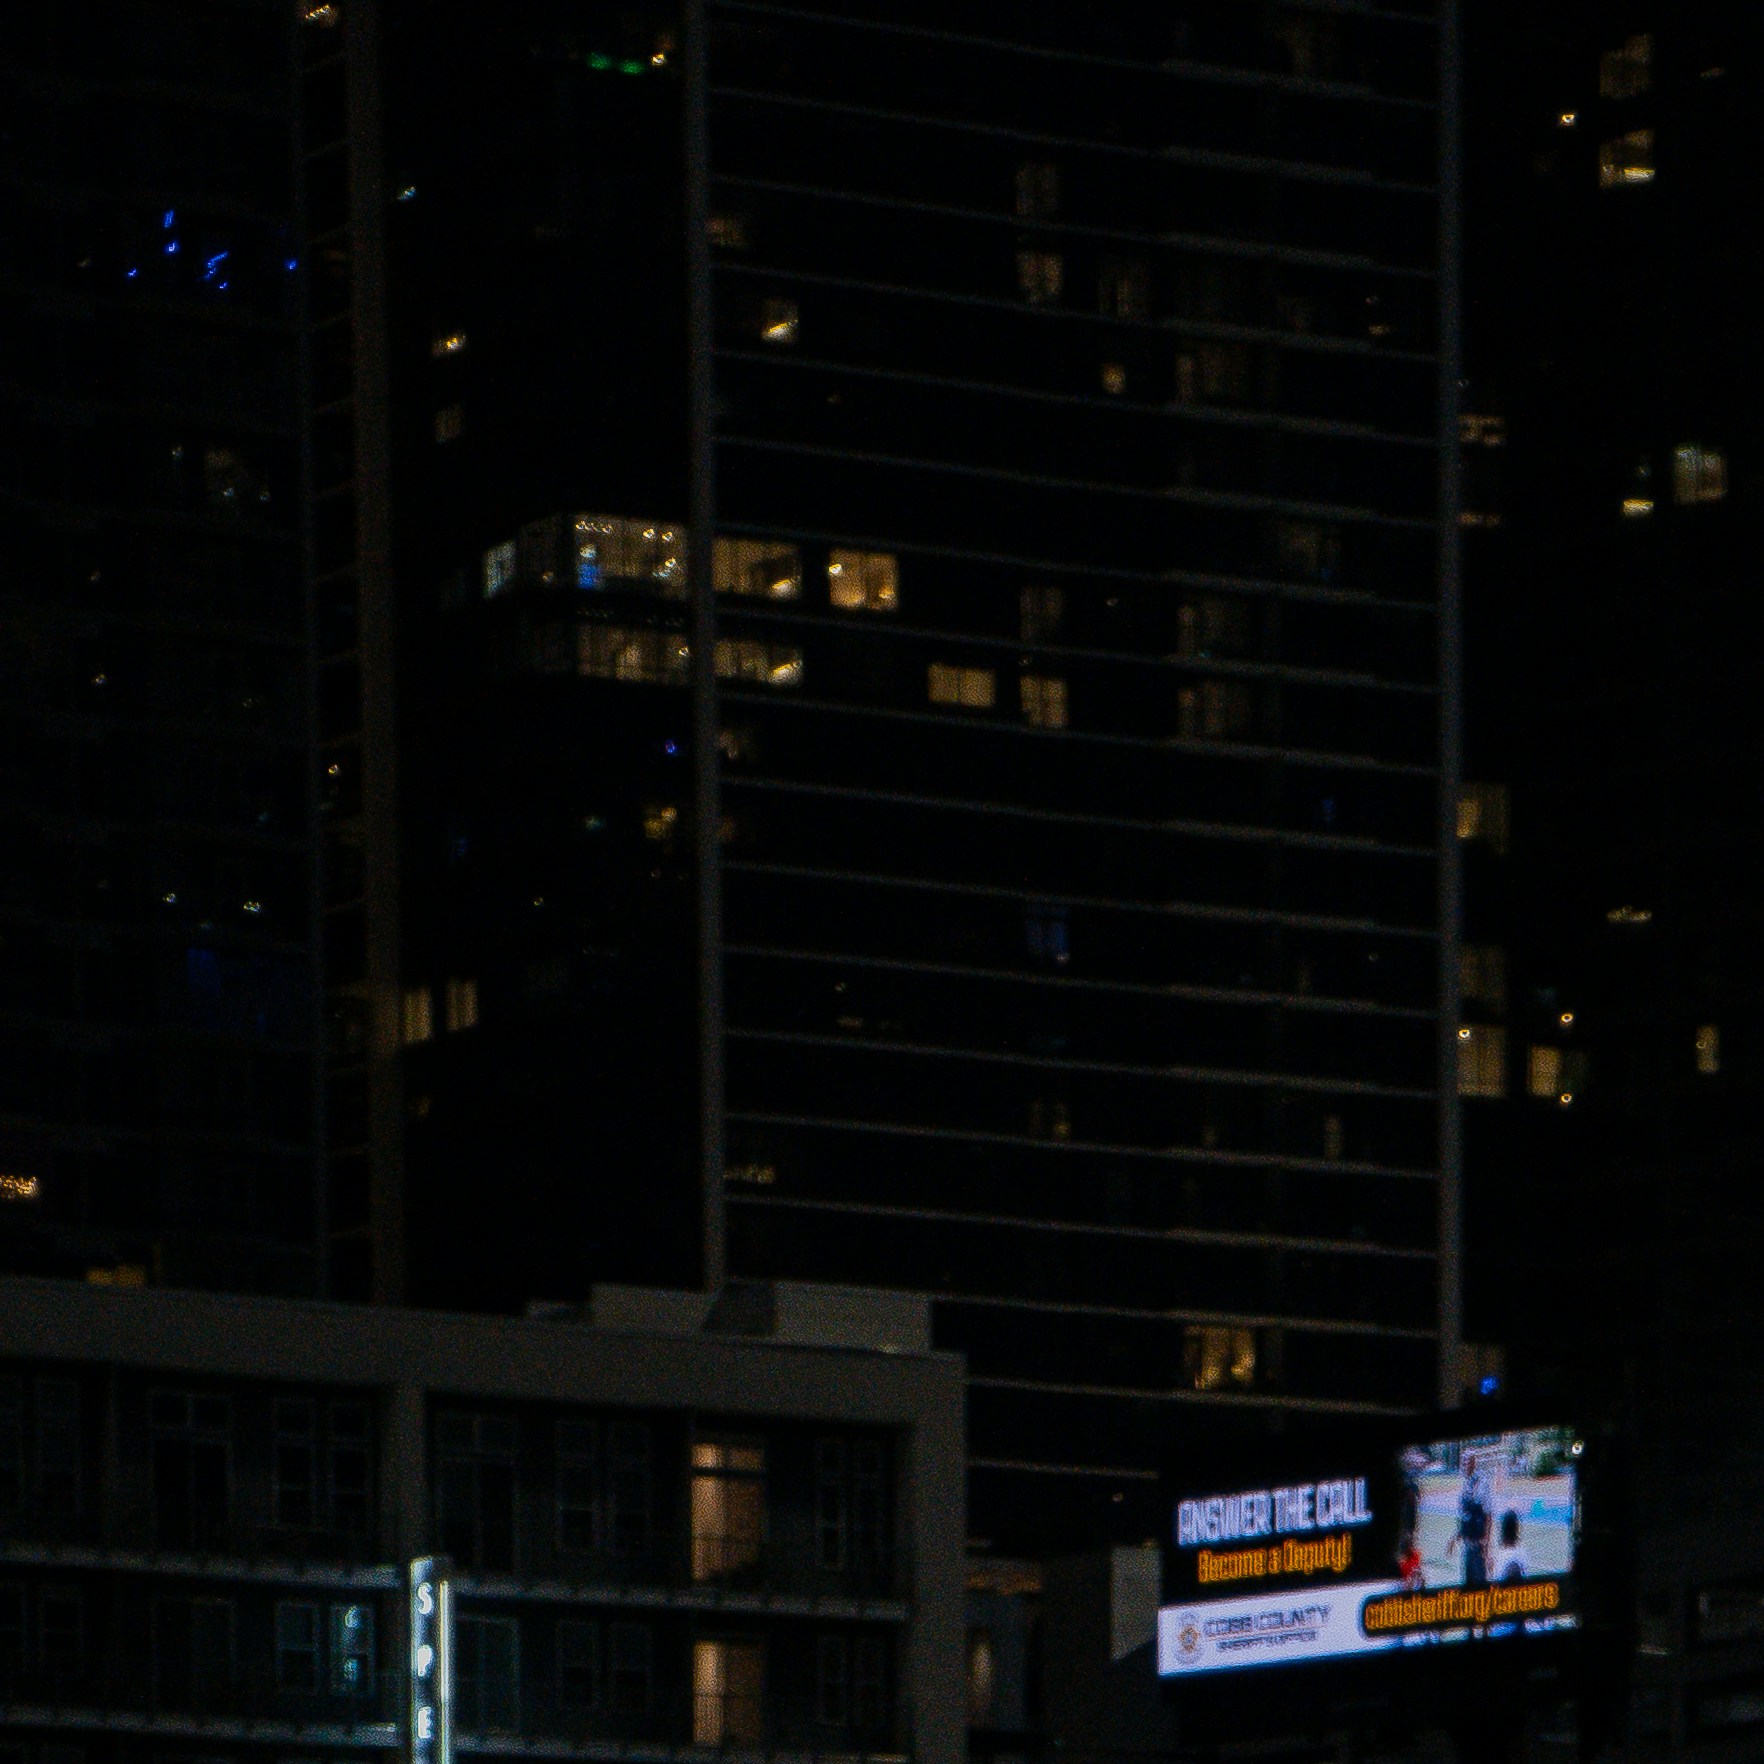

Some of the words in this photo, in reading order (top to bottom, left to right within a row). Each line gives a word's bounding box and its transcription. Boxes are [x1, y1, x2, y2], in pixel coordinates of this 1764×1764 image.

[1178, 1491, 1271, 1545] ANSWER
[1272, 1485, 1314, 1533] THE
[1316, 1477, 1372, 1528] CALL
[1198, 1549, 1267, 1583] Become
[1268, 1546, 1282, 1574] a
[1283, 1533, 1352, 1575] Deputy!
